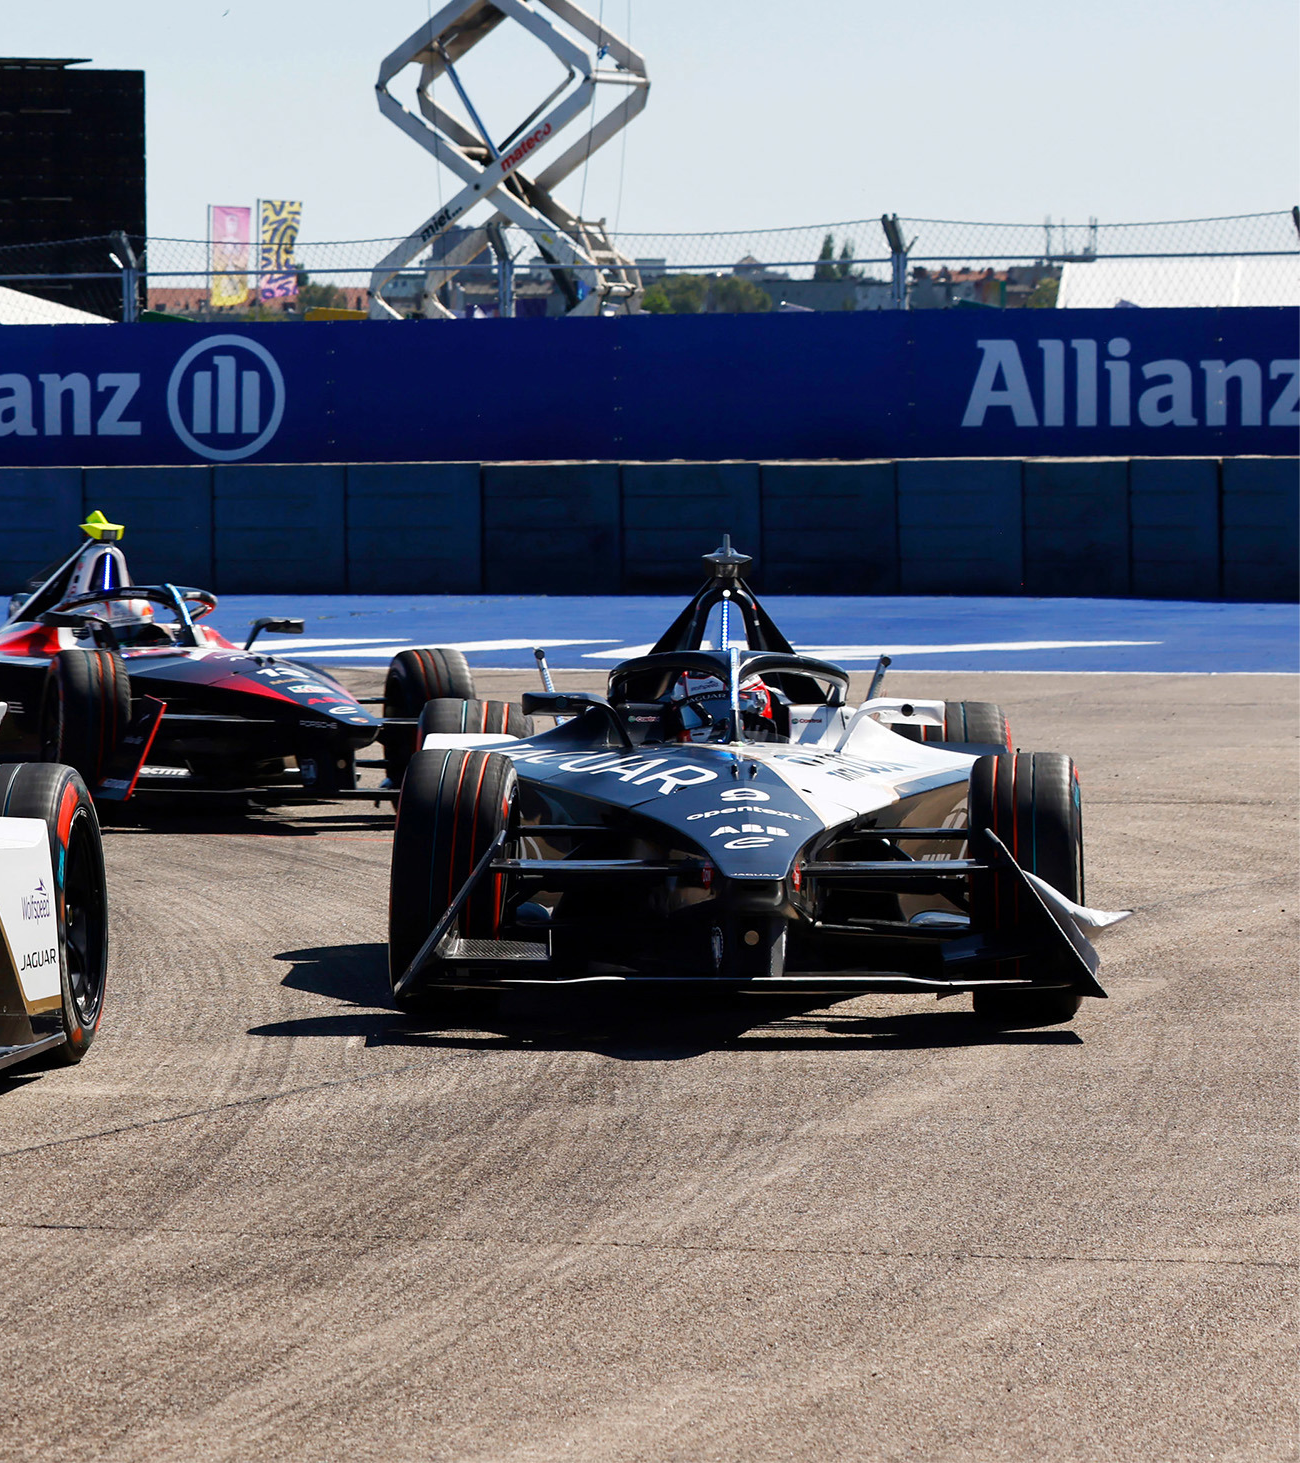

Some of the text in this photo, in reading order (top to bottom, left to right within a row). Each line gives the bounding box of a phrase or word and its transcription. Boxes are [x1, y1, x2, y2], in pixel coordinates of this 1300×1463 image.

[500, 122, 553, 172] mateco
[139, 767, 190, 777] OCTITE
[720, 787, 771, 802] 9
[709, 823, 790, 838] ABB
[21, 893, 51, 926] Wolfspeed
[20, 948, 57, 972] JAGUAR
